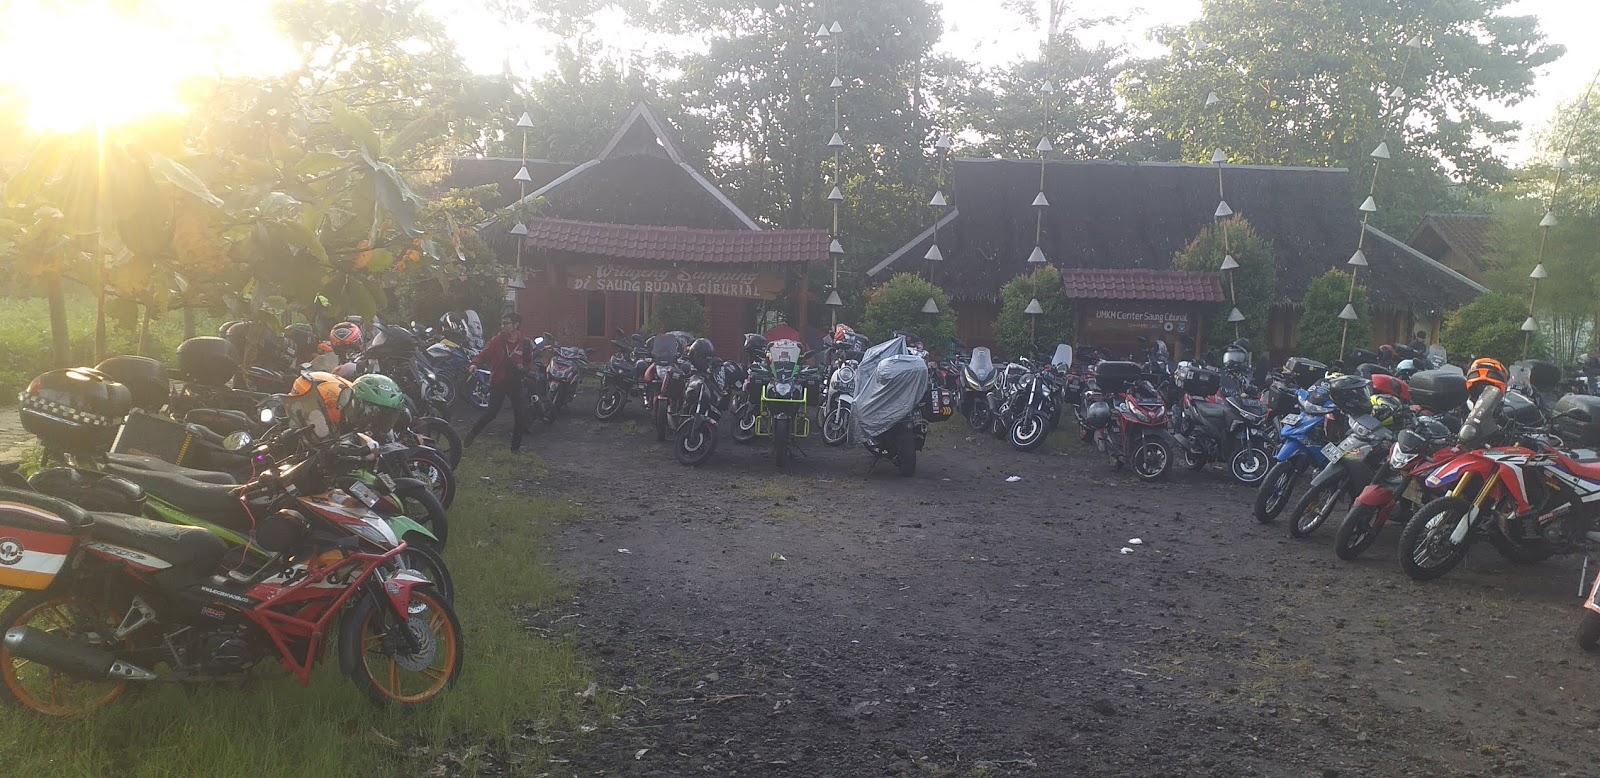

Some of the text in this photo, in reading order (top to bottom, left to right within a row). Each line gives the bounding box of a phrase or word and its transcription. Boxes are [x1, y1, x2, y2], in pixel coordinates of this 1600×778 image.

[597, 279, 640, 292] SAUNG
[645, 281, 693, 293] BUDAYA
[1096, 310, 1116, 319] UMKM
[1117, 311, 1143, 320] Center
[1144, 312, 1163, 323] Saung
